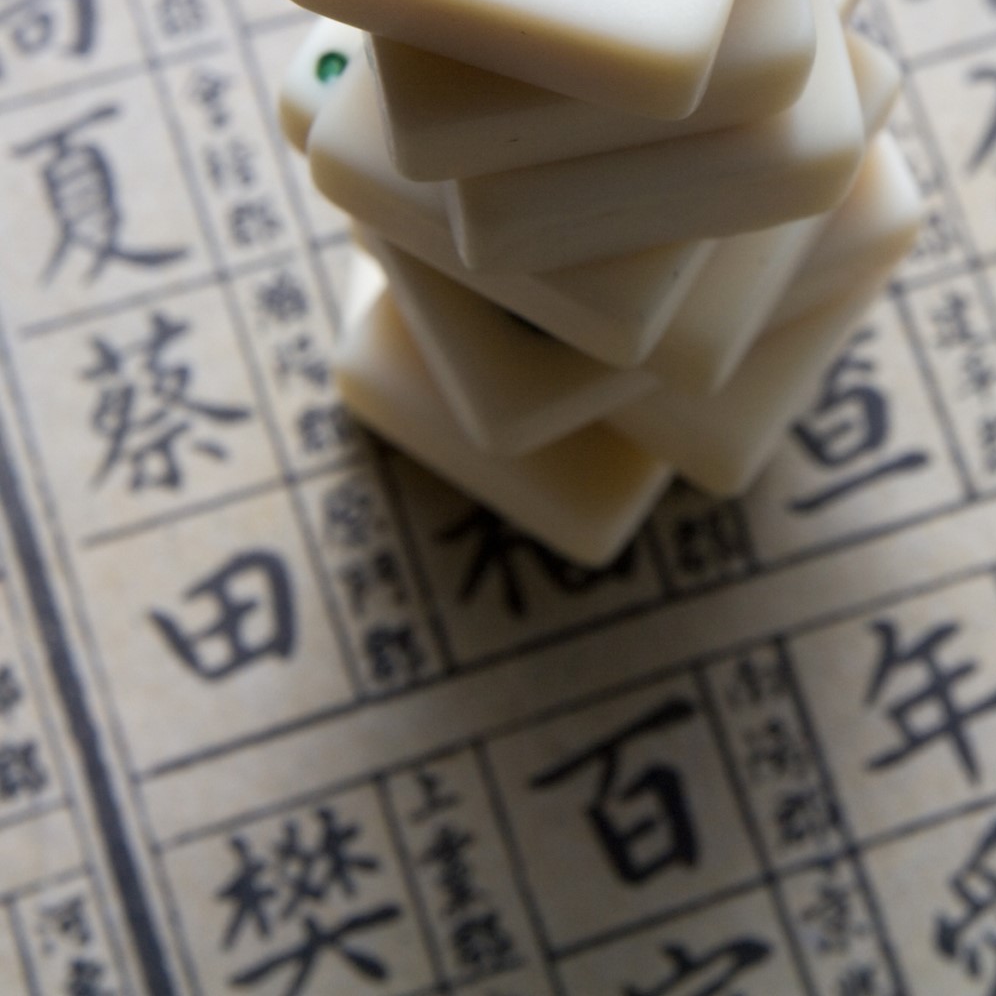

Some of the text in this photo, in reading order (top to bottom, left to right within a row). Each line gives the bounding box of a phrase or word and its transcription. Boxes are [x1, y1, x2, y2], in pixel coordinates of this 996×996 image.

[8, 105, 190, 289] 夏
[78, 311, 255, 492] 蔡
[148, 548, 296, 685] 田
[529, 694, 699, 888] 百
[216, 805, 402, 996] 樊
